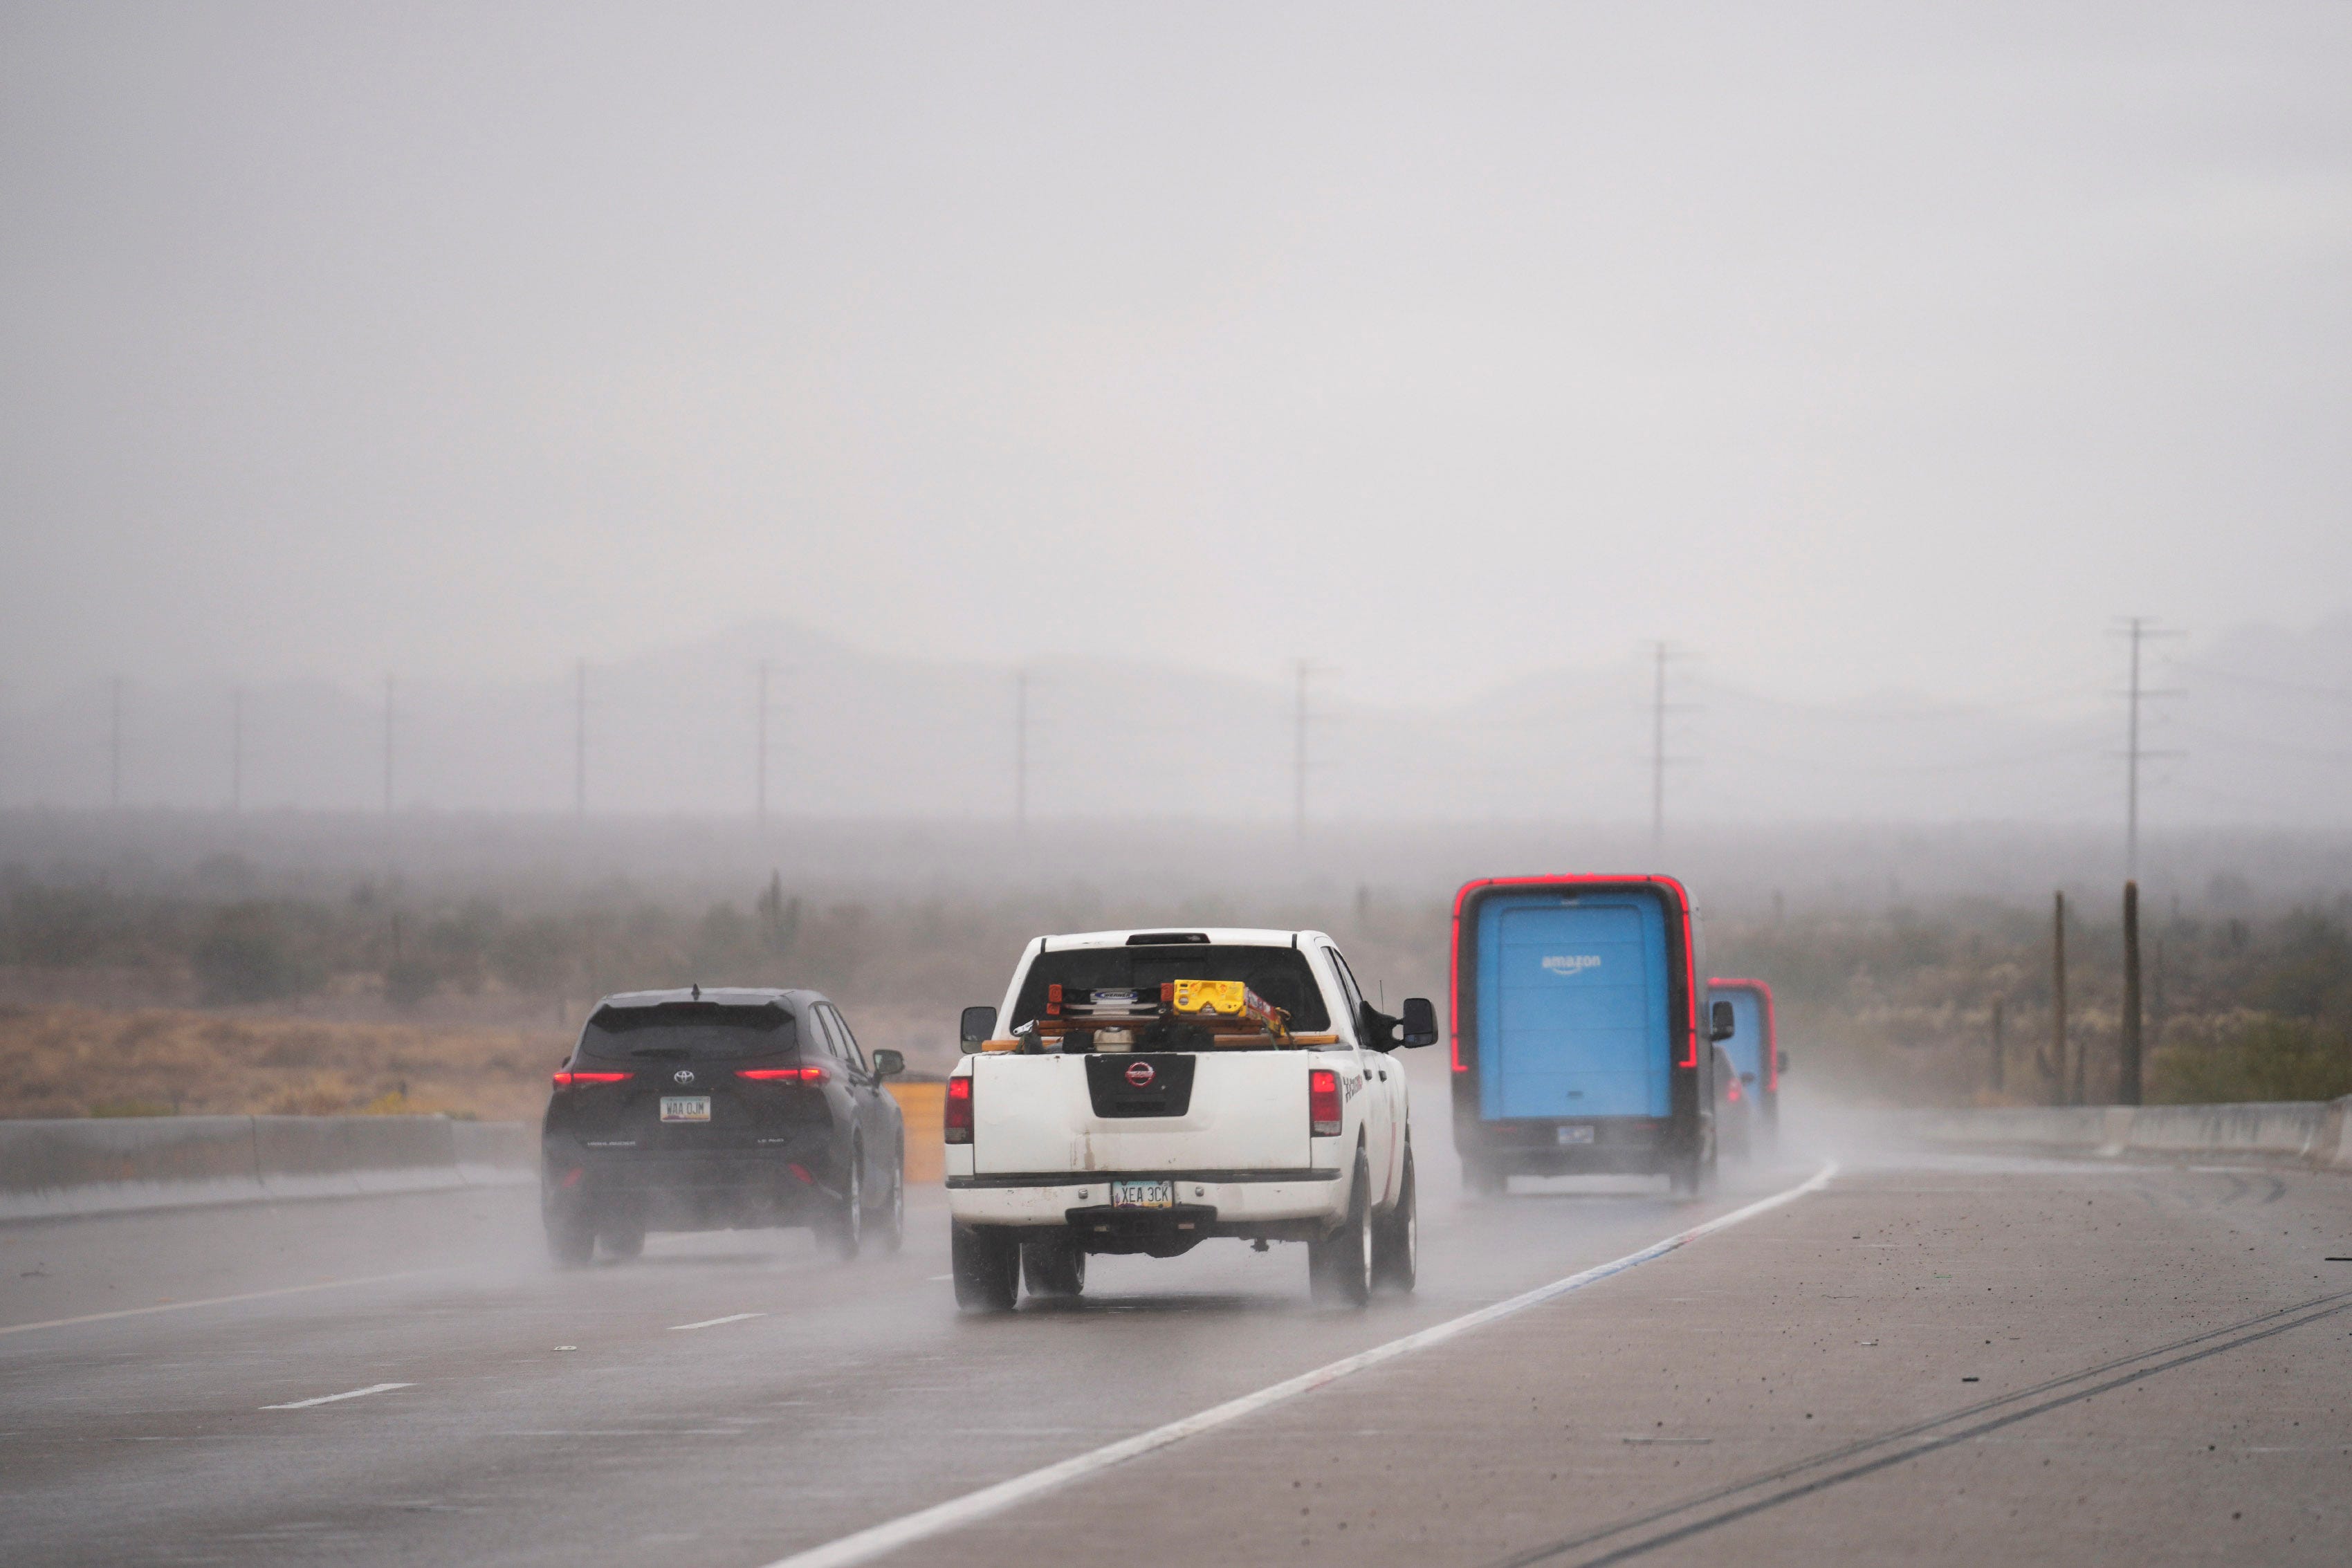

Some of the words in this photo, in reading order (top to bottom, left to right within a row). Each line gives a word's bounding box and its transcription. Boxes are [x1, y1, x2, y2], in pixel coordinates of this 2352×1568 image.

[1542, 955, 1601, 968] amazon
[1122, 1187, 1143, 1202] XEA
[1148, 1187, 1168, 1202] 3CK
